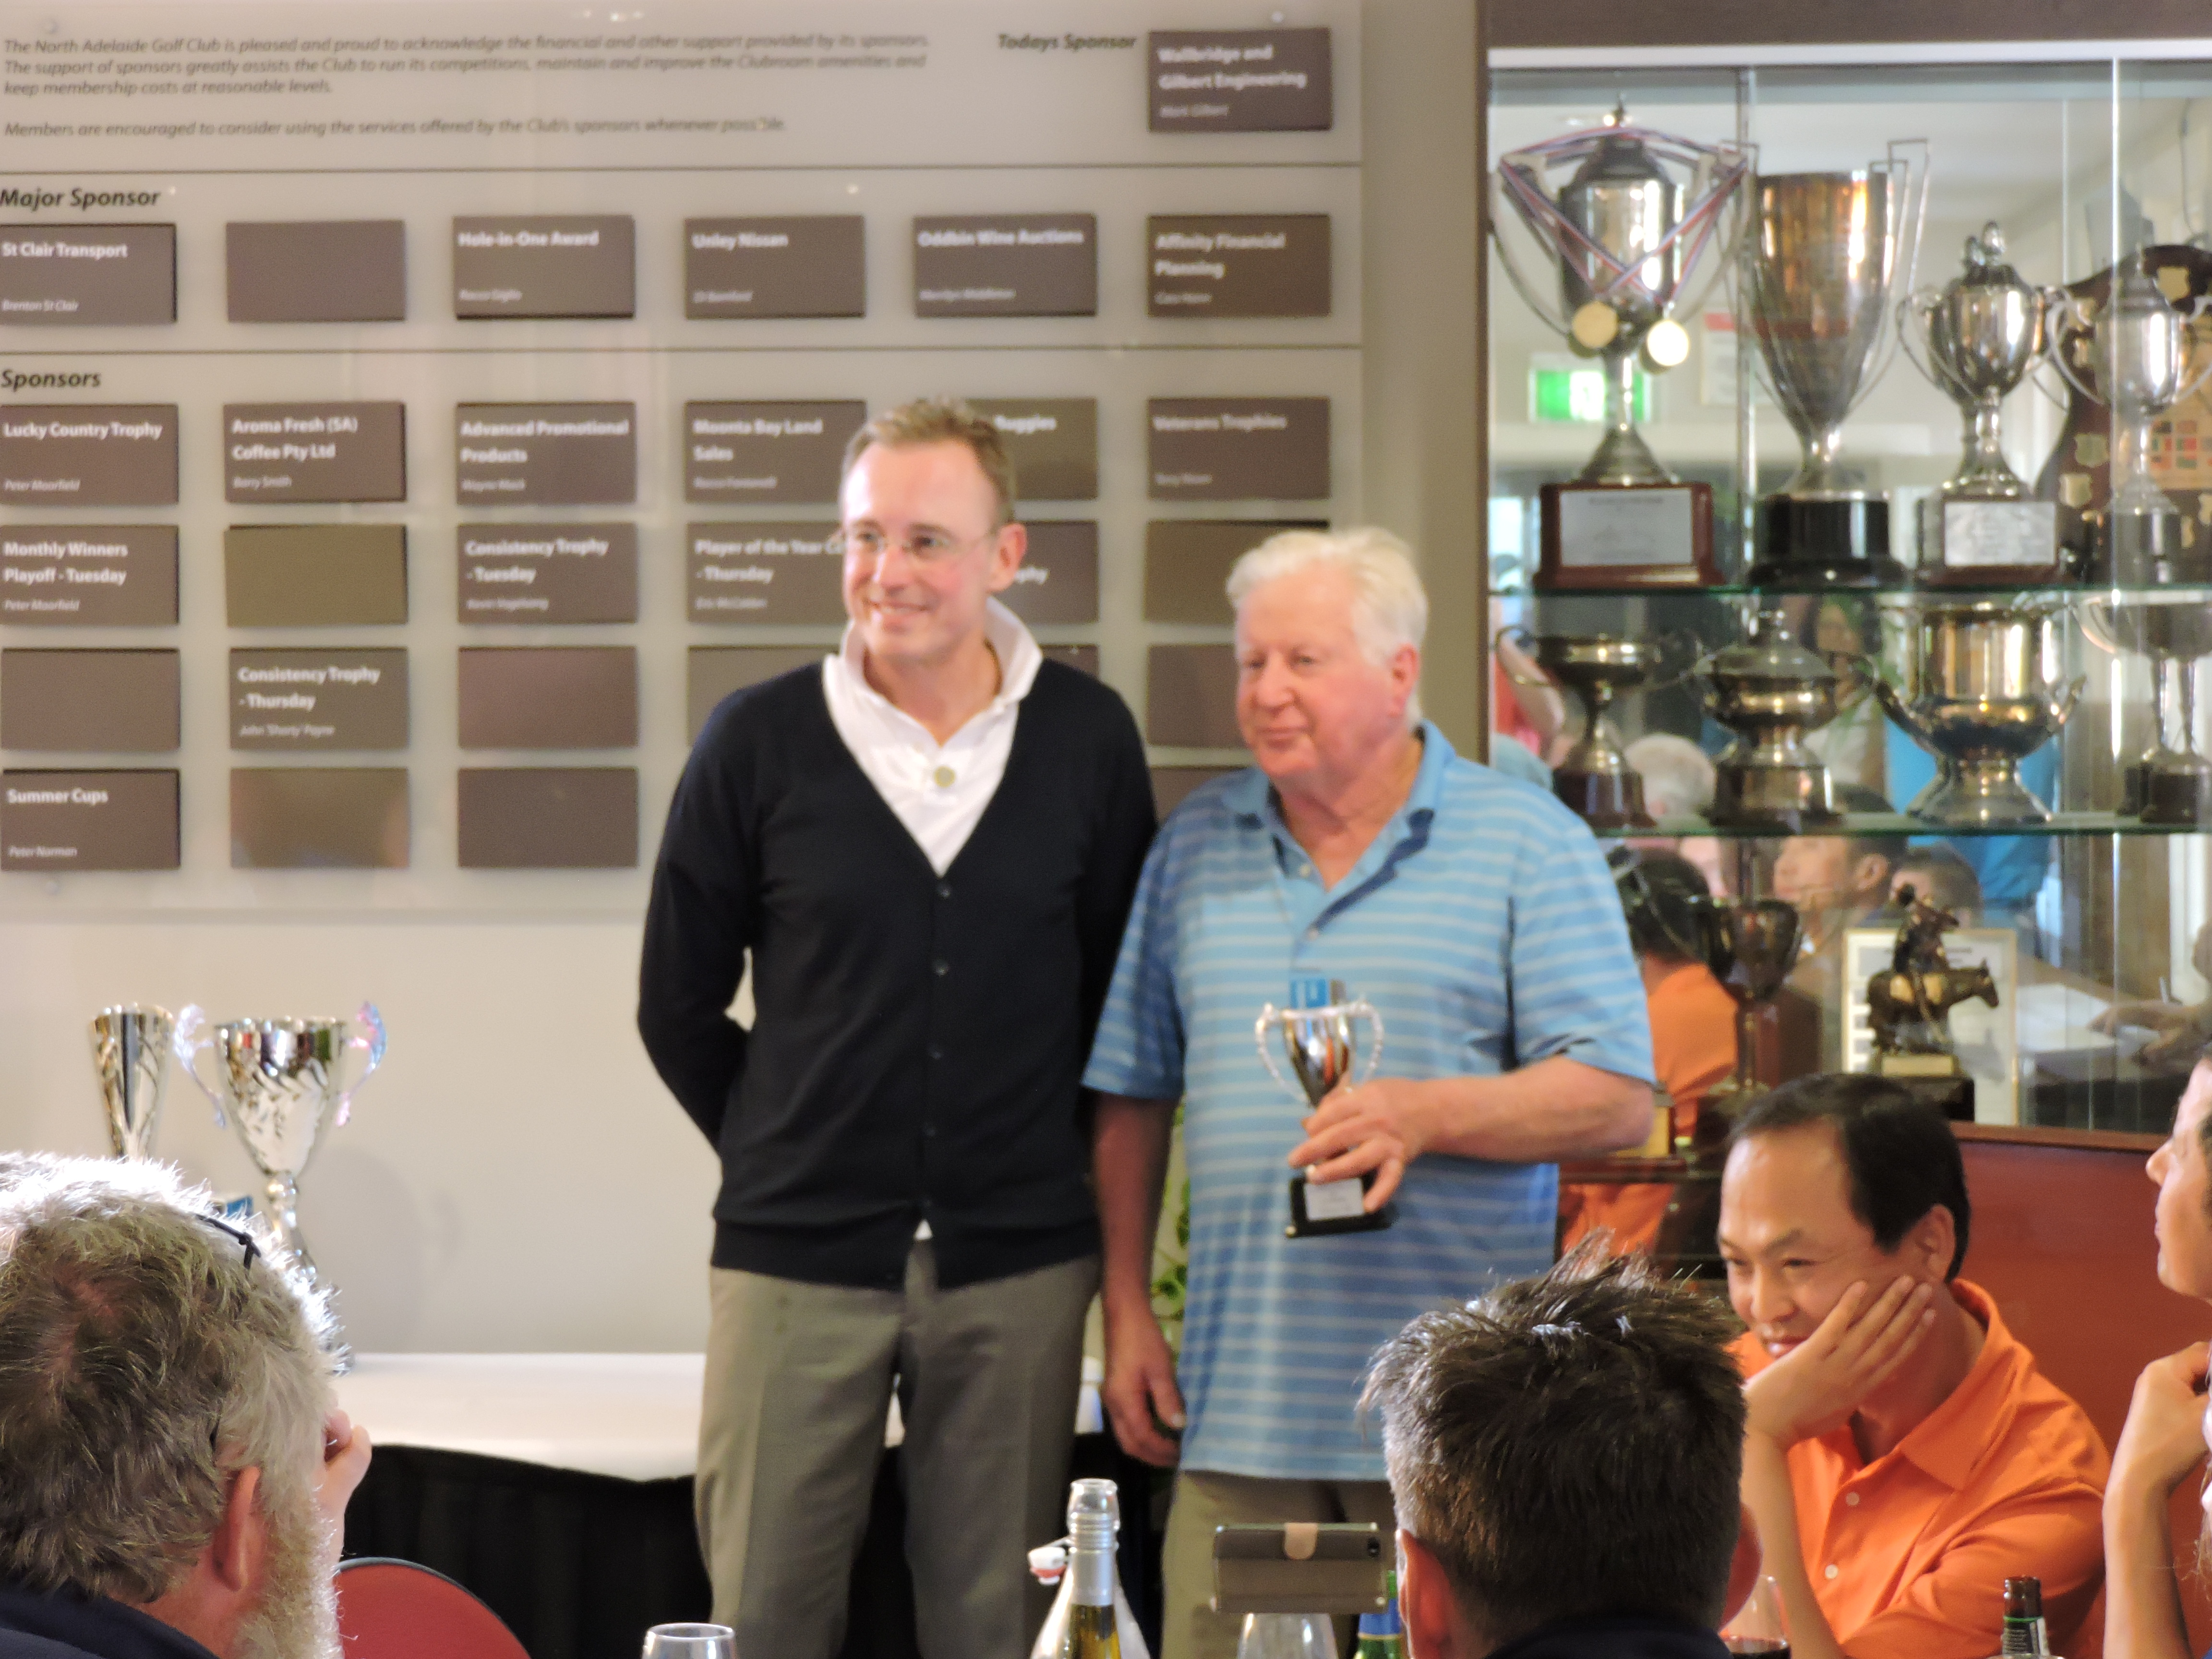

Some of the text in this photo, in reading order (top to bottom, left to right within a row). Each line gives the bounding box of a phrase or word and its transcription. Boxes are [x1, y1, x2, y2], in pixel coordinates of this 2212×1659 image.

[5, 39, 33, 54] The
[34, 40, 79, 54] North
[82, 40, 149, 54] Adelaide
[151, 39, 185, 53] Golf
[186, 39, 222, 53] Club
[225, 40, 236, 52] is
[238, 39, 299, 55] pleased
[300, 38, 332, 52] and
[333, 38, 381, 55] proud
[383, 39, 400, 51] to
[402, 36, 505, 55] acknowledge
[506, 36, 533, 50] the
[535, 35, 603, 50] financial
[602, 36, 637, 50] and
[636, 35, 681, 50] other
[680, 36, 744, 52] support
[743, 34, 816, 52] provided
[814, 34, 837, 51] by
[836, 35, 857, 48] its
[999, 34, 1140, 53] Todays Sponsor
[1242, 45, 1274, 61] and
[5, 60, 32, 75] The
[35, 62, 95, 78] support
[96, 60, 115, 74] of
[116, 63, 183, 77] sponsors
[186, 60, 240, 77] greatly
[241, 60, 291, 73] assists
[294, 58, 320, 72] the
[321, 58, 358, 72] Club
[361, 60, 377, 72] to
[379, 60, 406, 72] run
[409, 59, 426, 72] its
[536, 58, 608, 71] maintain
[607, 56, 643, 71] and
[640, 57, 708, 73] improve
[707, 55, 736, 70] the
[735, 53, 816, 70] Clubroom
[814, 55, 893, 69] amenities
[892, 55, 927, 69] and
[4, 81, 40, 98] keep
[42, 81, 139, 97] membership
[139, 82, 179, 95] costs
[181, 82, 199, 95] at
[201, 80, 287, 94] reasonable
[4, 122, 75, 137] Members
[77, 125, 104, 136] are
[104, 122, 197, 140] encouraged
[199, 123, 216, 135] to
[217, 121, 283, 135] consider
[285, 122, 328, 138] using
[329, 120, 355, 134] the
[358, 122, 417, 134] services
[419, 119, 476, 134] offered
[474, 119, 497, 136] by
[498, 120, 524, 133] the
[574, 121, 642, 135] sponsors
[643, 118, 720, 133] whenever
[0, 188, 160, 212] Major Sponsor
[549, 231, 600, 247] Award
[975, 230, 1016, 245] Wine
[1016, 230, 1084, 245] Auctions
[1214, 234, 1286, 249] Financial
[2, 242, 128, 260] St Clair Transport
[1155, 260, 1225, 279] Planning
[1, 369, 101, 393] Sponsors
[4, 422, 163, 441] Lucky Country Trophy
[232, 420, 283, 434] Aroma
[283, 417, 325, 433] Fresh
[461, 421, 629, 437] Advanced Promotional
[753, 419, 783, 437] Bay
[783, 420, 823, 435] Land
[232, 444, 336, 462] Coffee Pty Ltd
[461, 448, 528, 463] Products
[694, 446, 733, 461] Sales
[4, 480, 31, 492] Peter
[4, 542, 129, 560] Monthly Winners
[465, 539, 609, 557] Consistency Trophy
[695, 540, 743, 558] Player
[743, 540, 762, 555] of
[762, 540, 789, 555] the
[789, 540, 822, 555] Year
[3, 567, 57, 586] Playoff
[66, 568, 127, 586] Tuesday
[475, 566, 537, 584] Tuesday
[704, 565, 774, 584] Thursday
[4, 600, 31, 611] Peter
[238, 666, 381, 685] Consistency Trophy
[247, 693, 316, 711] Thursday
[7, 788, 108, 806] Summer Cups
[8, 846, 78, 858] Peter Norman
